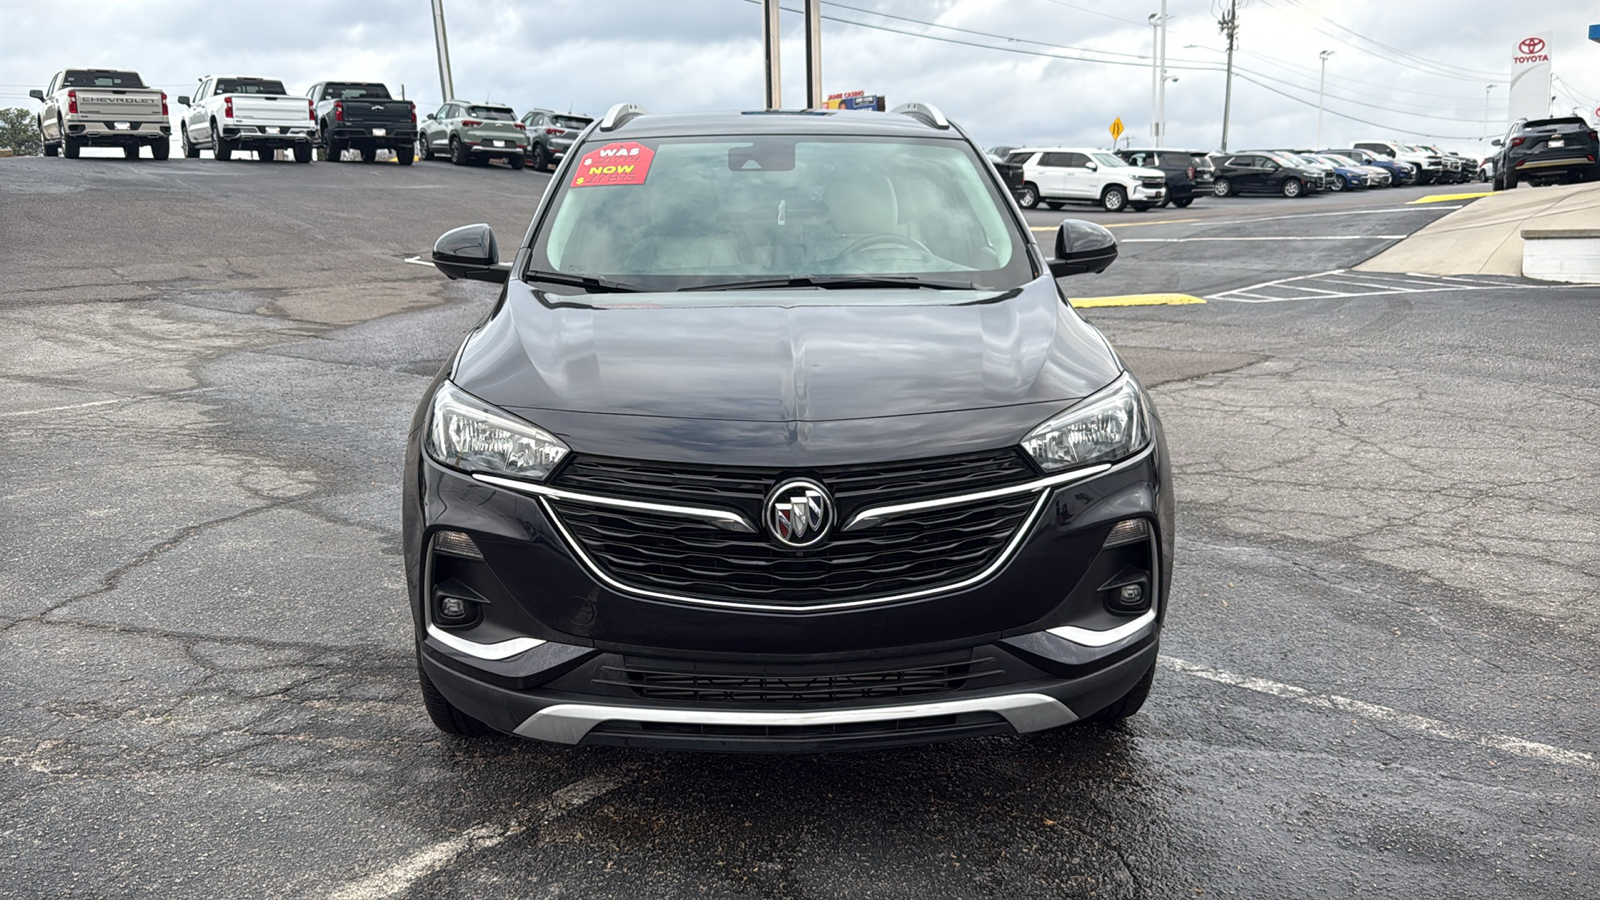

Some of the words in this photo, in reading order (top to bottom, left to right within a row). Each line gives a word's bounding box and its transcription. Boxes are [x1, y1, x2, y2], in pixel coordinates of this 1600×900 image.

[1514, 54, 1549, 64] TOYOTA
[599, 147, 641, 157] WAS
[588, 164, 636, 175] NOW
